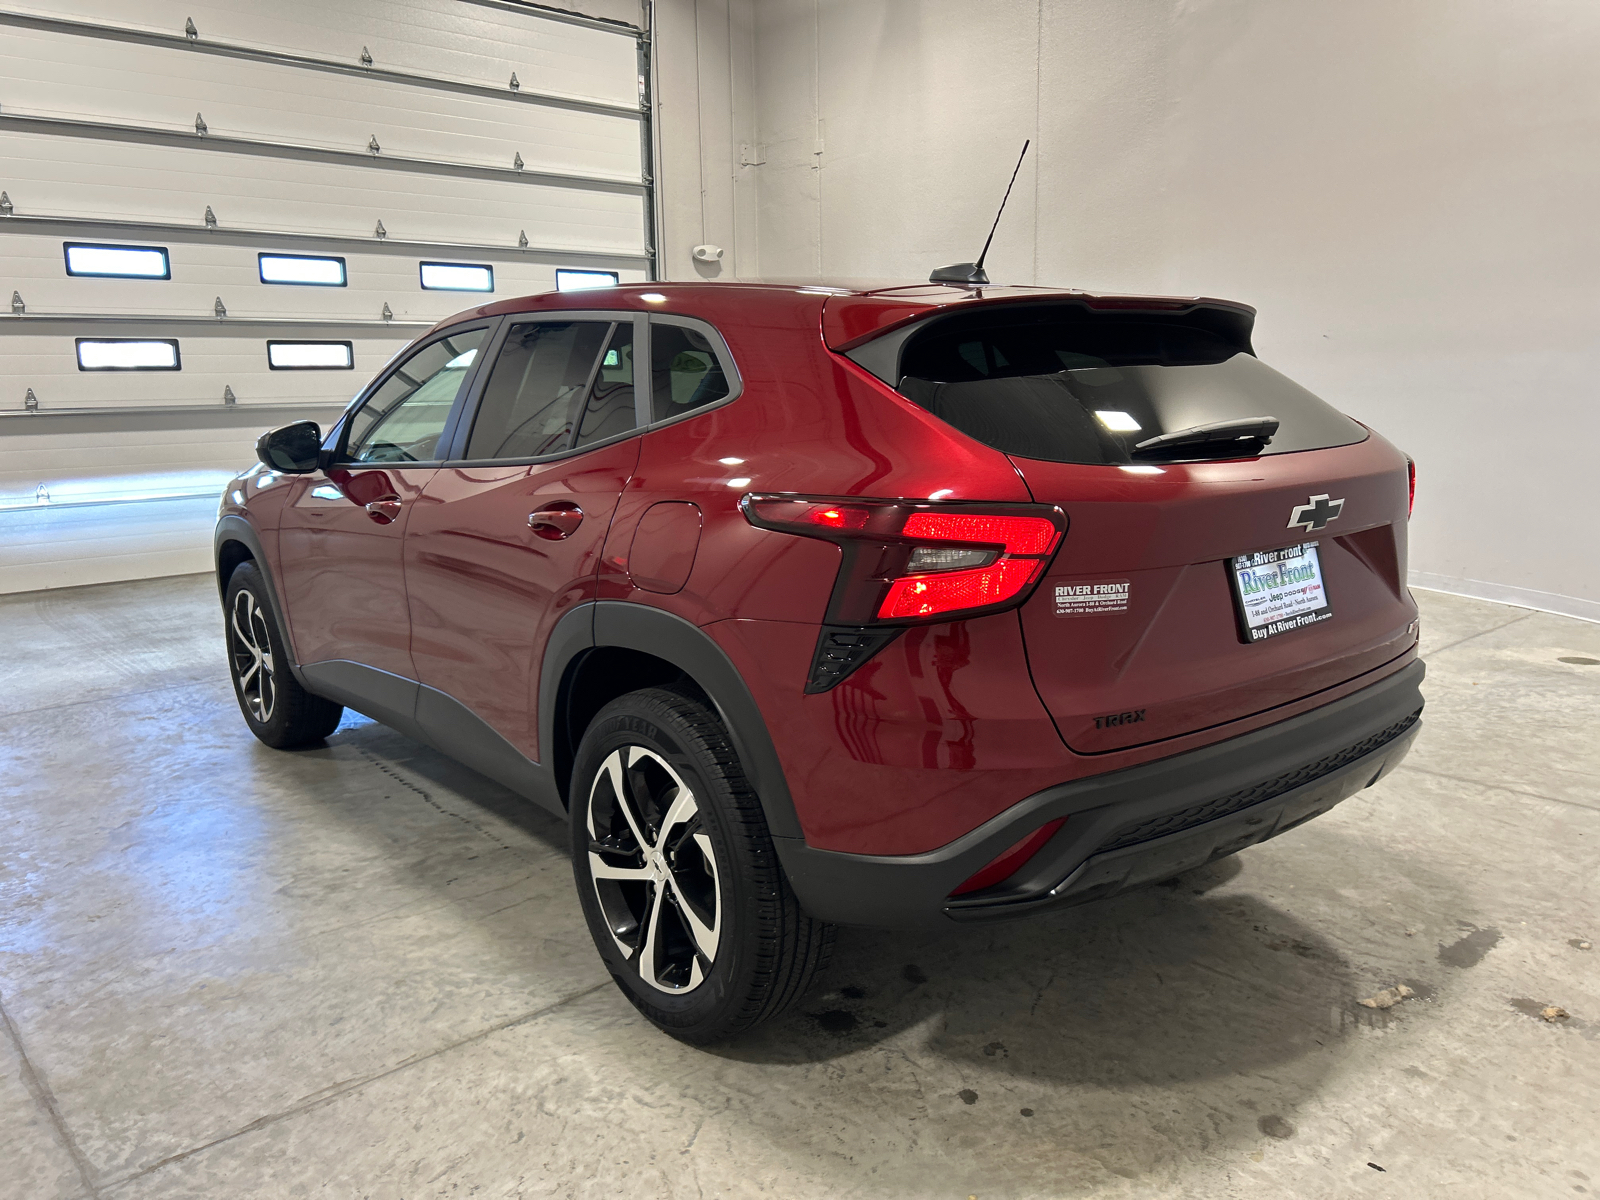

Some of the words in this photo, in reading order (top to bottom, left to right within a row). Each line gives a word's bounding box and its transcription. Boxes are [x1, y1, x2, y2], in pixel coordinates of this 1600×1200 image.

[1254, 551, 1278, 565] River
[1240, 570, 1279, 595] River
[1277, 561, 1316, 587] Front
[1055, 586, 1091, 596] RIVER
[1093, 583, 1130, 594] FRONT
[1269, 592, 1284, 602] Jeep
[1267, 604, 1284, 614] Orchard
[1295, 599, 1306, 607] North
[1251, 627, 1268, 640] Buy
[1268, 623, 1278, 636] At
[1277, 618, 1297, 632] River
[1093, 709, 1146, 729] TRAX
